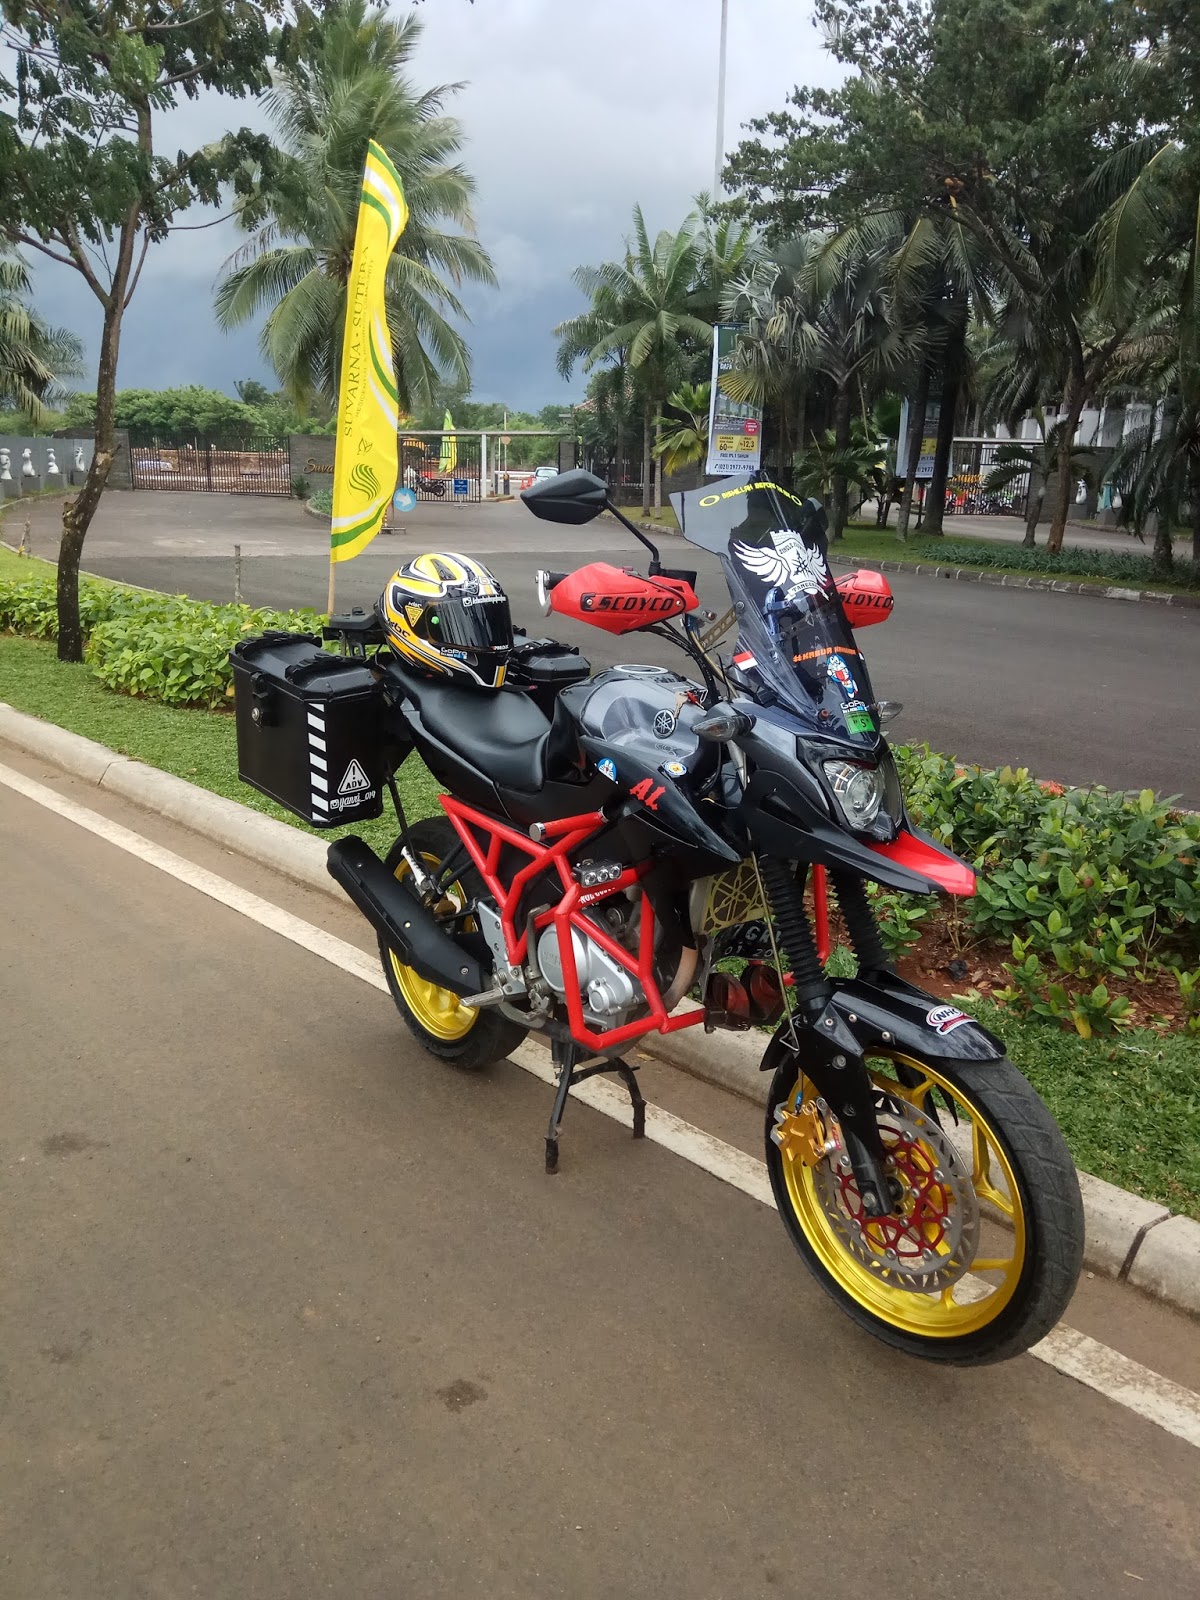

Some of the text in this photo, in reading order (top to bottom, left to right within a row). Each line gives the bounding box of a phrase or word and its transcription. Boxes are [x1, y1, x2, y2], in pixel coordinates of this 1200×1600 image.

[344, 246, 369, 437] SUVARNA SUTERA
[599, 597, 675, 611] SCOYCO
[441, 647, 468, 657] GoPro
[346, 779, 363, 790] ADV
